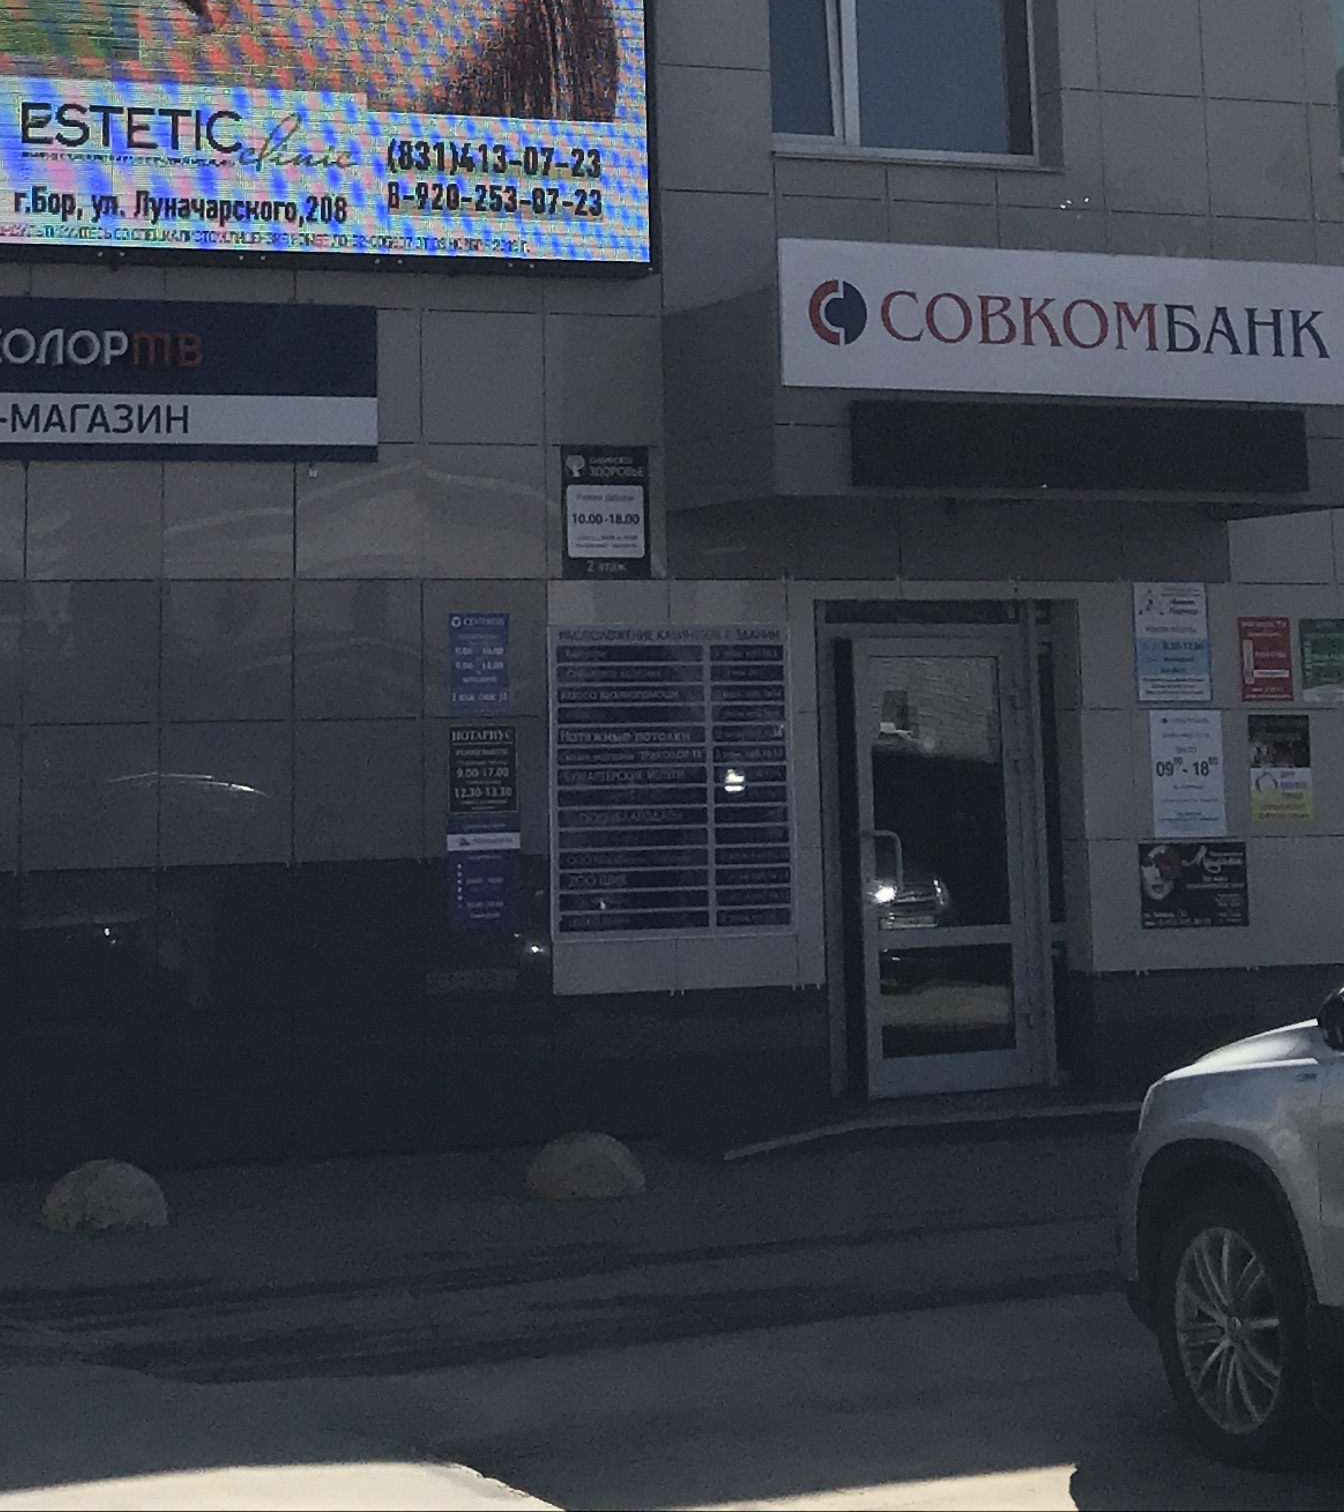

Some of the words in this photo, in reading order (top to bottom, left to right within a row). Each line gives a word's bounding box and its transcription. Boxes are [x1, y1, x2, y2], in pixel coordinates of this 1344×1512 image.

[21, 101, 243, 154] ESTETIC
[238, 112, 357, 172] clinic
[387, 139, 602, 178] (831)413-07-23
[14, 185, 83, 221] г.Бор,
[91, 193, 126, 221] ул.
[880, 289, 1331, 359] СОВКОМБАНК
[452, 730, 514, 741] НОТАРИУС
